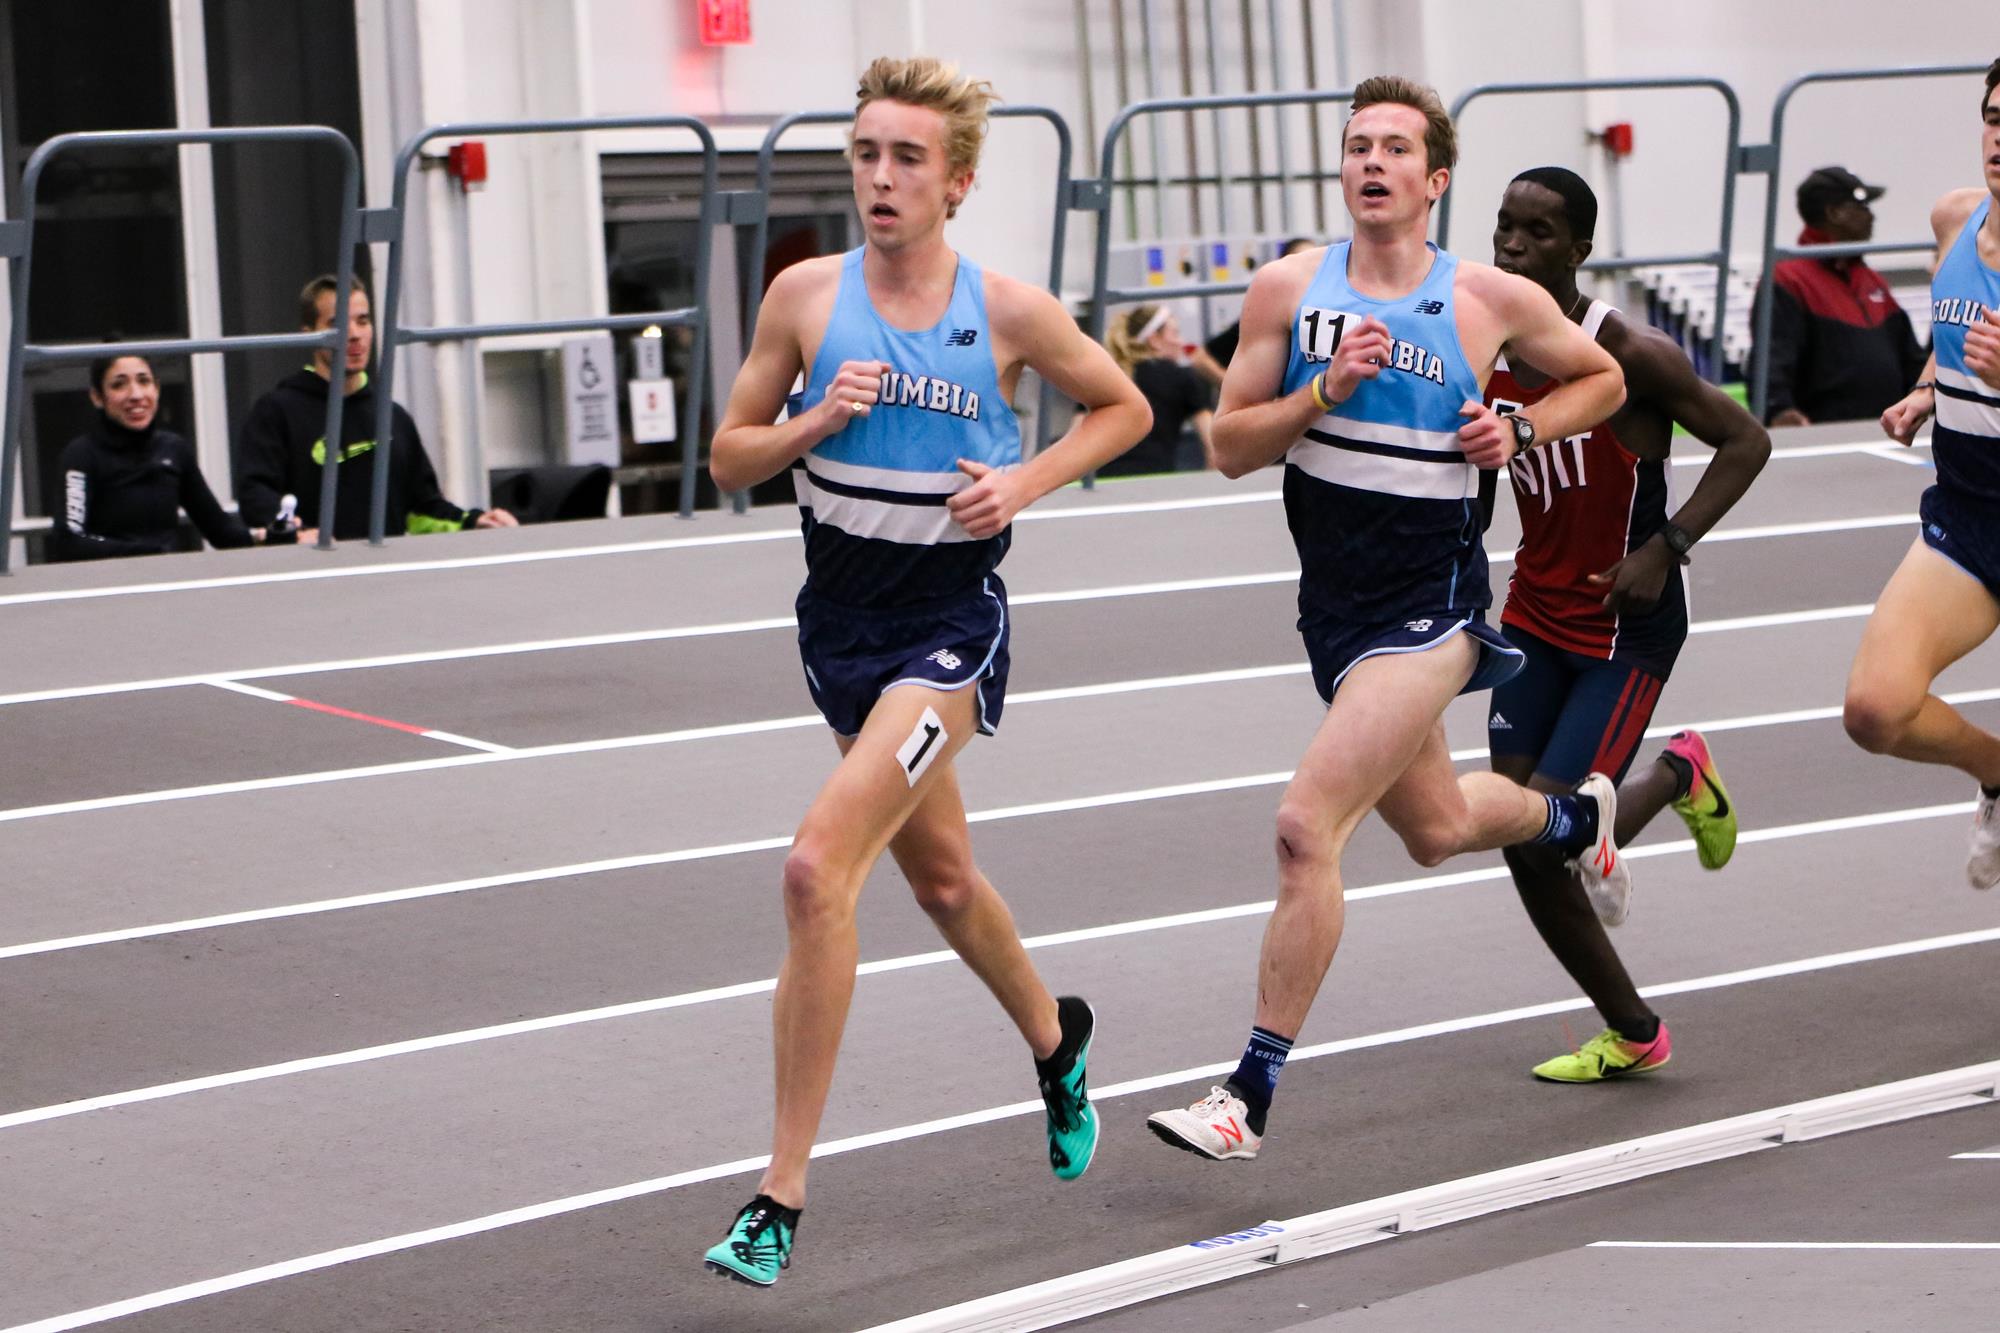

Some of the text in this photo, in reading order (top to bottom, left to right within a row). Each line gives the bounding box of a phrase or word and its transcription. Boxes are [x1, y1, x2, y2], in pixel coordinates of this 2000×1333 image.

[1304, 310, 1346, 356] 11
[1933, 298, 1986, 328] COLU
[825, 372, 980, 421] UMBIA
[1511, 431, 1593, 514] NJIT
[908, 723, 940, 774] 1
[1189, 1225, 1285, 1250] MONDO
